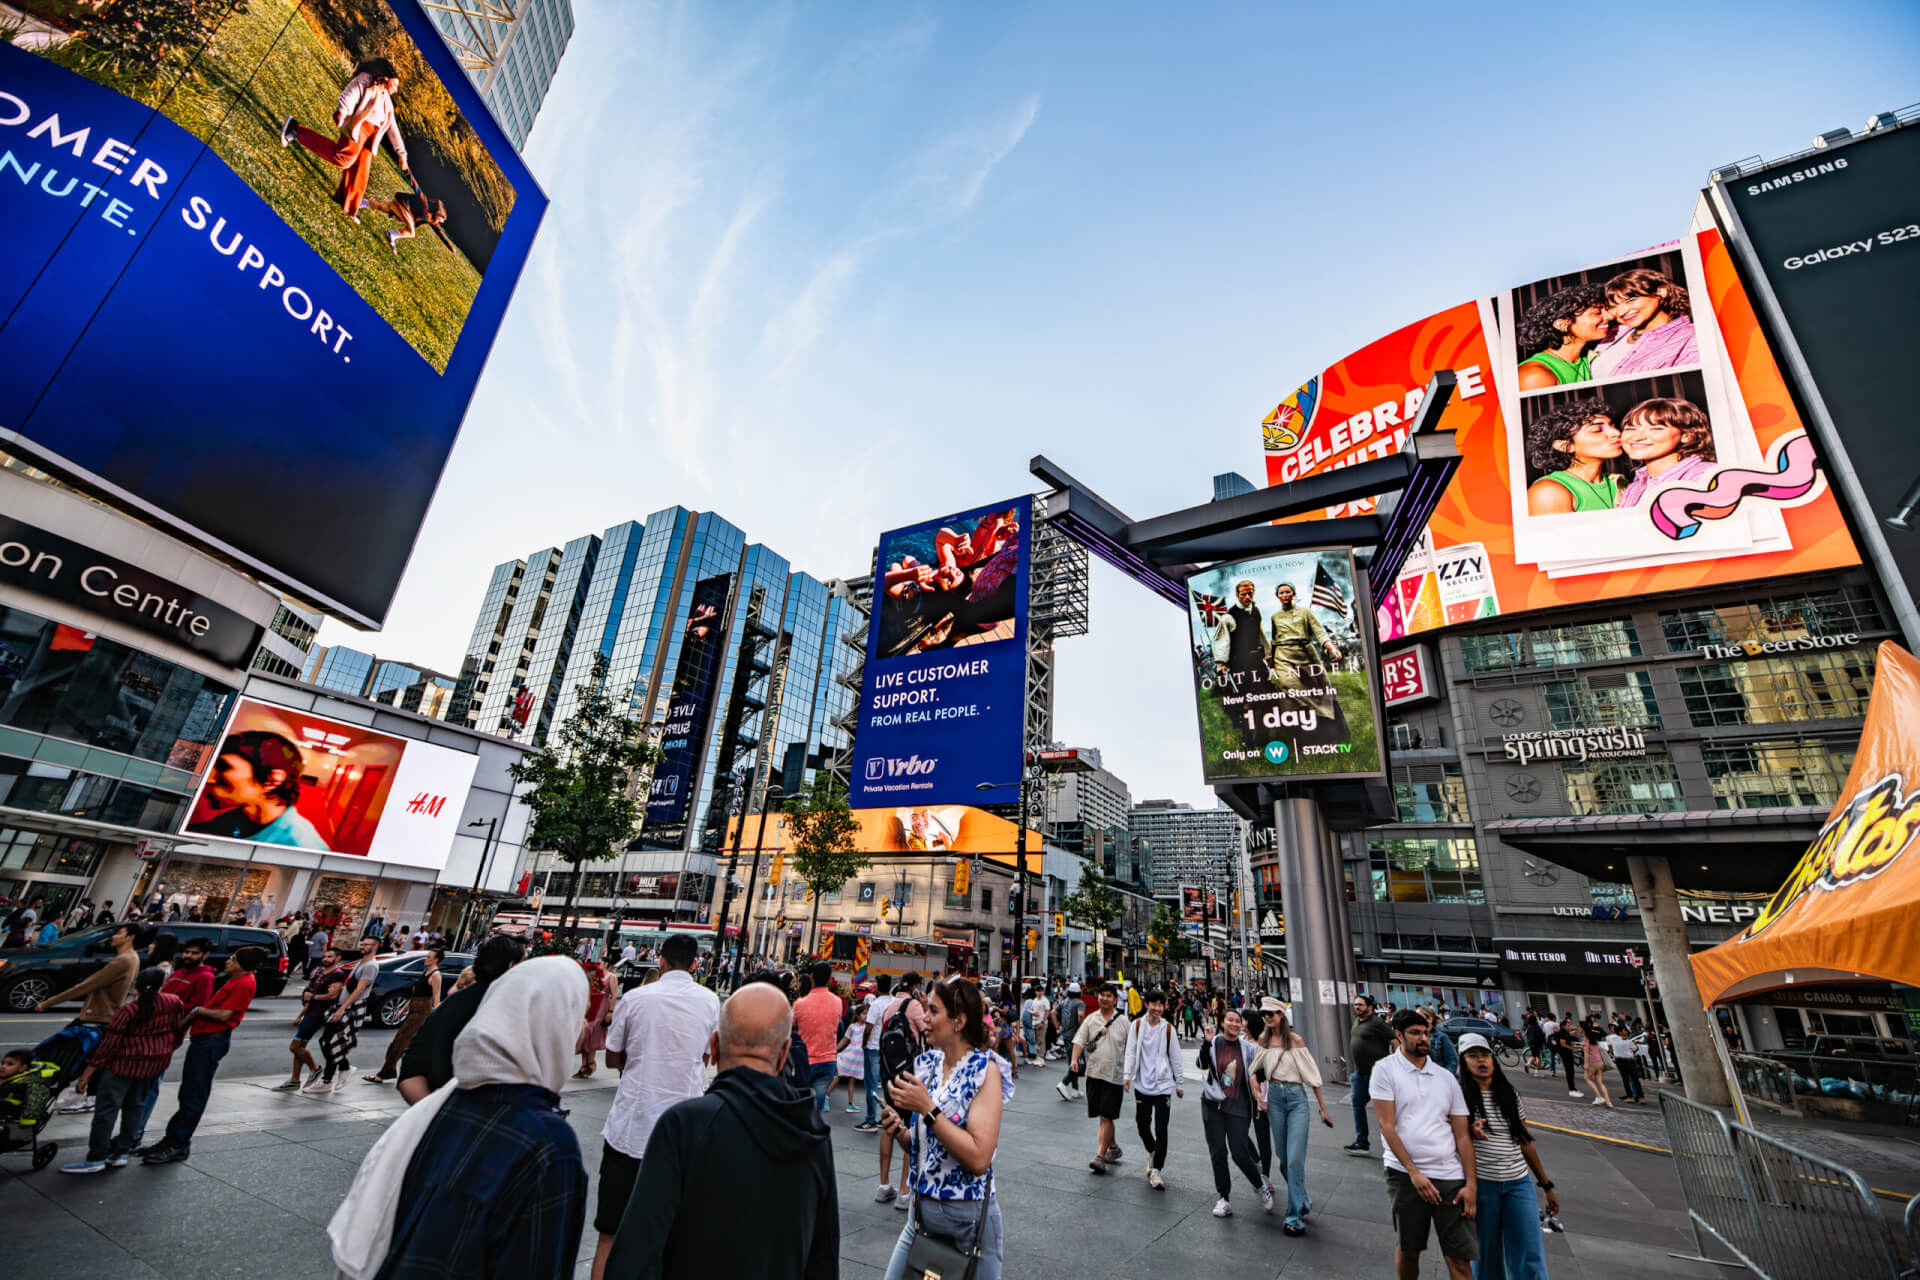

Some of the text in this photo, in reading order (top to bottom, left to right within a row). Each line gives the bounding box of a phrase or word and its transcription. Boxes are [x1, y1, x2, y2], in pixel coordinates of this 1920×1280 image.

[1747, 158, 1848, 196] SAMSUNG
[1783, 224, 1920, 270] Galaxy S23
[181, 196, 353, 362] SUPPORT.
[1281, 364, 1486, 483] CELEBRAE
[0, 540, 211, 637] on Centre
[1697, 643, 1743, 660] The
[1798, 632, 1860, 650] Store
[875, 659, 990, 689] LIVE CUSTOMER
[1202, 661, 1360, 690] OUTLANDER
[873, 688, 940, 709] SUPPORT.
[1223, 685, 1337, 706] New Season Starts in
[871, 704, 980, 727] FROM REAL PEOPLE.
[1243, 706, 1318, 731] 1 day
[1503, 726, 1618, 742] LOUNGE RESTAURANT
[1223, 743, 1352, 761] Only on W STACKTV
[887, 754, 939, 777] Vrbo
[884, 783, 910, 792] Vacation
[911, 782, 934, 790] Rentals
[406, 791, 447, 819] H&M
[312, 910, 353, 928] Sale
[1553, 906, 1591, 918] ULTRA
[1520, 952, 1567, 962] THE TENOR
[1603, 954, 1622, 964] THE
[1803, 991, 1854, 1004] CANADA
